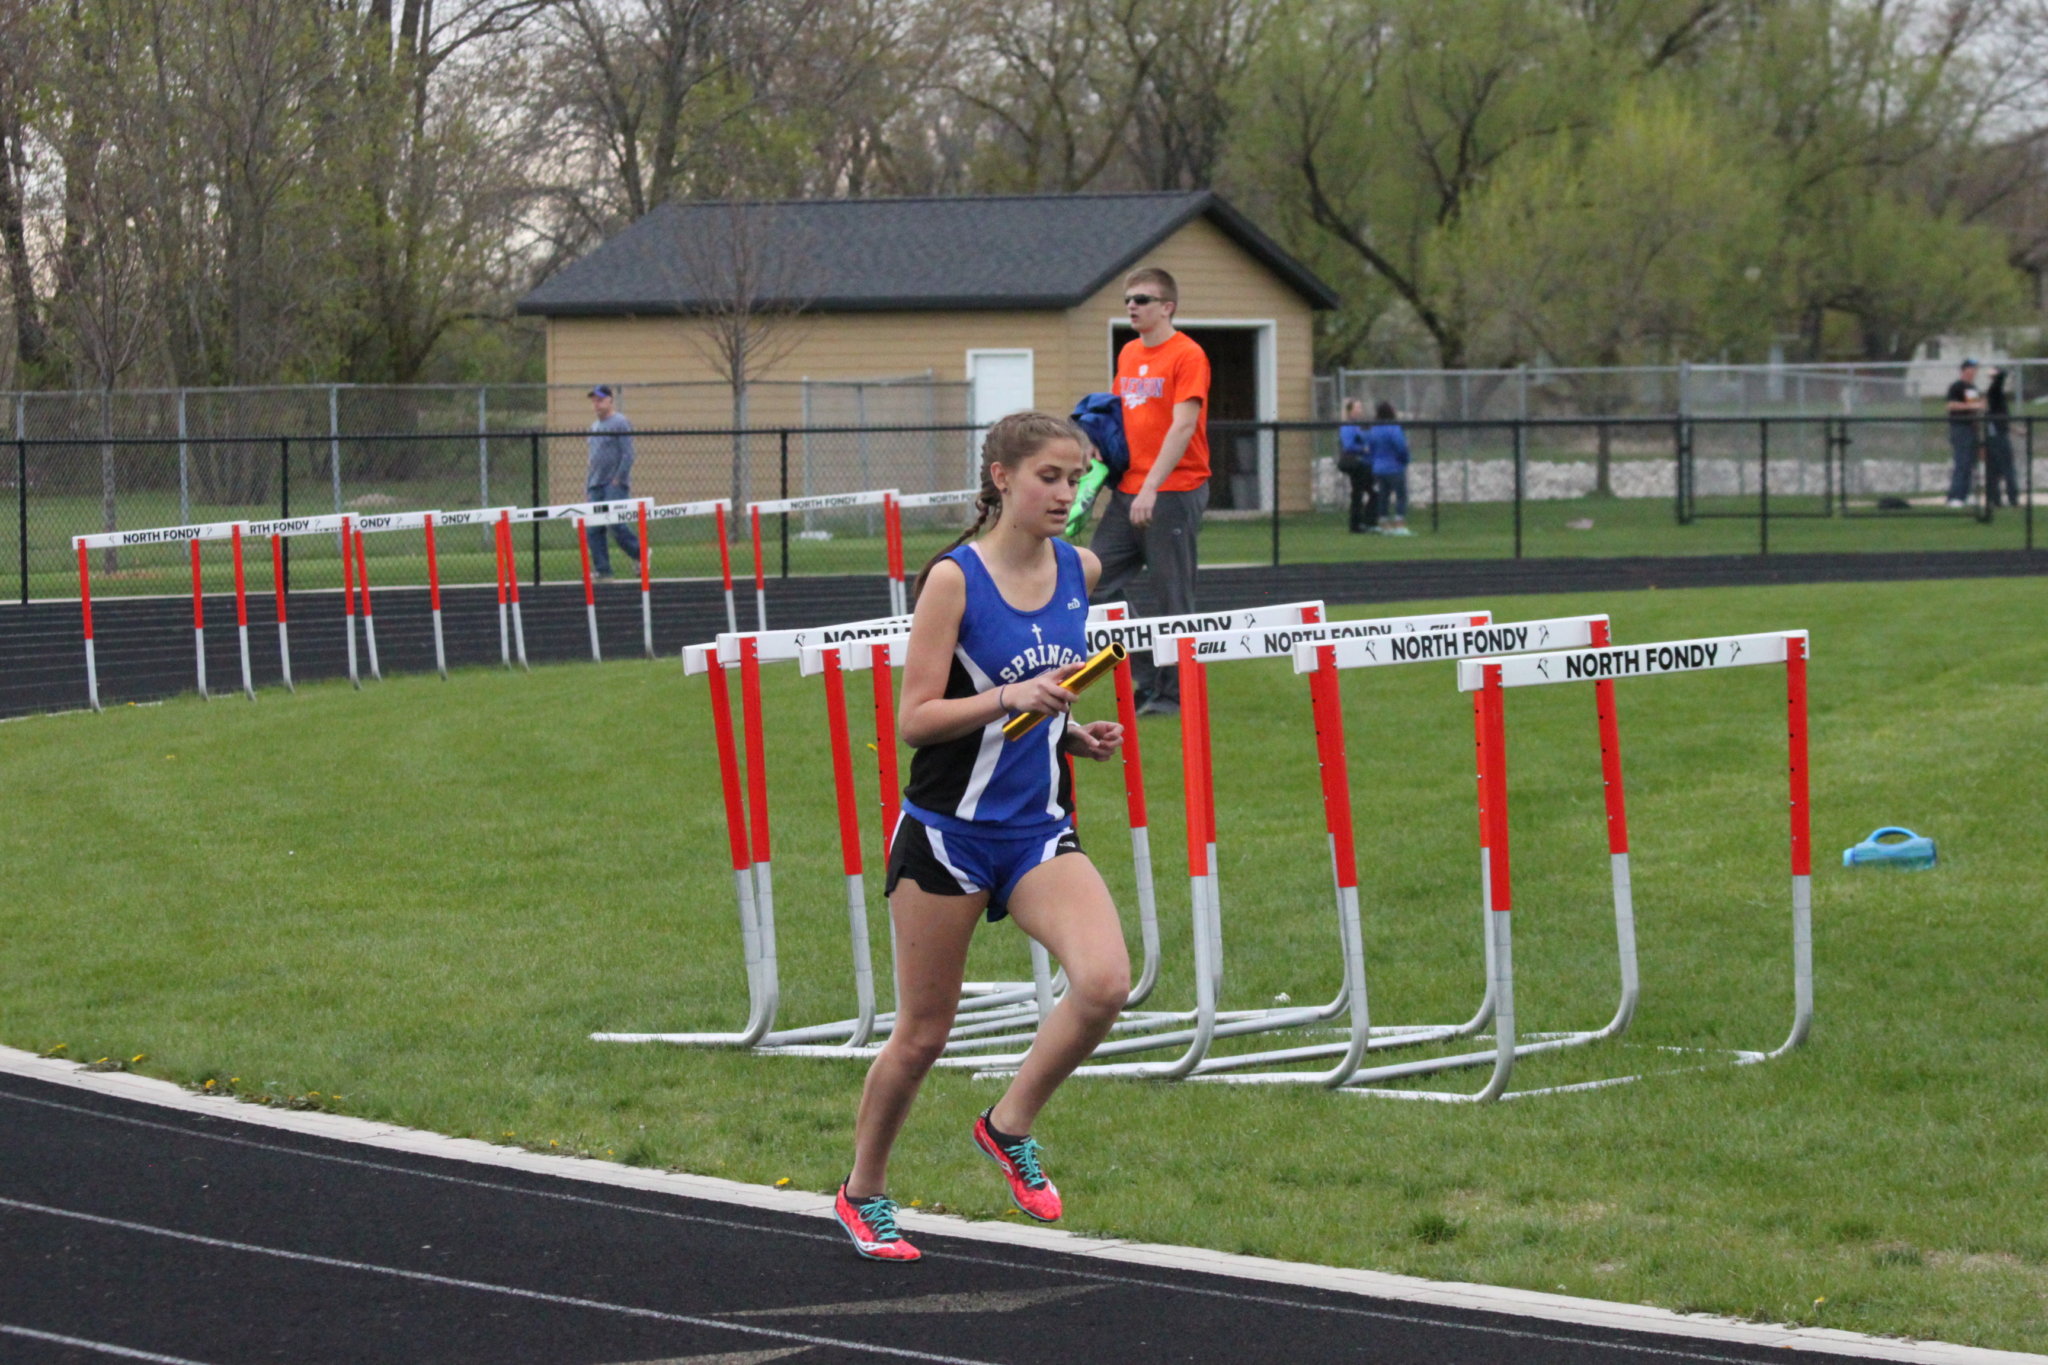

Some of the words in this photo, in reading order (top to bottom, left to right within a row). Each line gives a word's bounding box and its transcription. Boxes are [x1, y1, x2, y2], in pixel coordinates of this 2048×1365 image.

[790, 498, 822, 509] NORTH
[824, 496, 857, 506] FONDY
[441, 514, 471, 525] ONDY
[618, 509, 653, 522] NORH
[654, 506, 687, 518] FONDY
[249, 524, 271, 535] RTH
[272, 521, 309, 533] FONDY
[360, 517, 391, 528] ONDY
[123, 531, 160, 544] NORTH
[163, 527, 201, 540] FONDY
[1198, 641, 1227, 655] GILL
[1391, 632, 1458, 660] NORTH
[1463, 626, 1527, 655] FONDY
[1566, 650, 1639, 678] NORTH
[1646, 643, 1718, 671] FONDY
